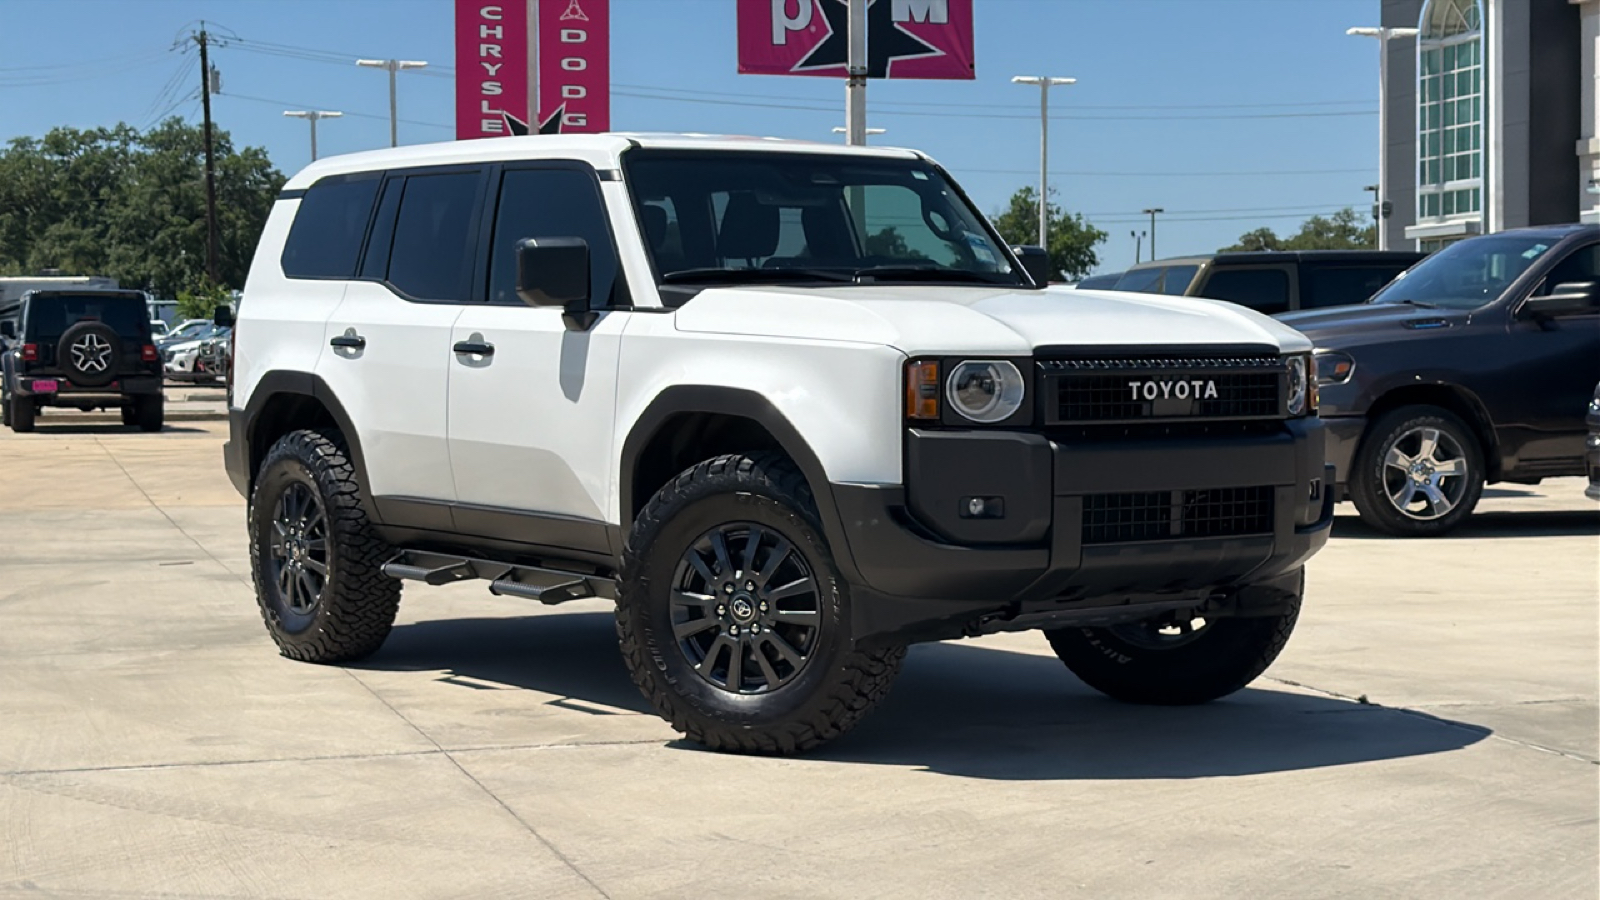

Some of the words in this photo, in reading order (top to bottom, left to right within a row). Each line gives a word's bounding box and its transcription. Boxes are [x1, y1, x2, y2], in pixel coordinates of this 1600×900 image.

[479, 6, 503, 133] CHRYSLE
[560, 29, 587, 126] DODG
[1128, 380, 1218, 400] TOYOTA
